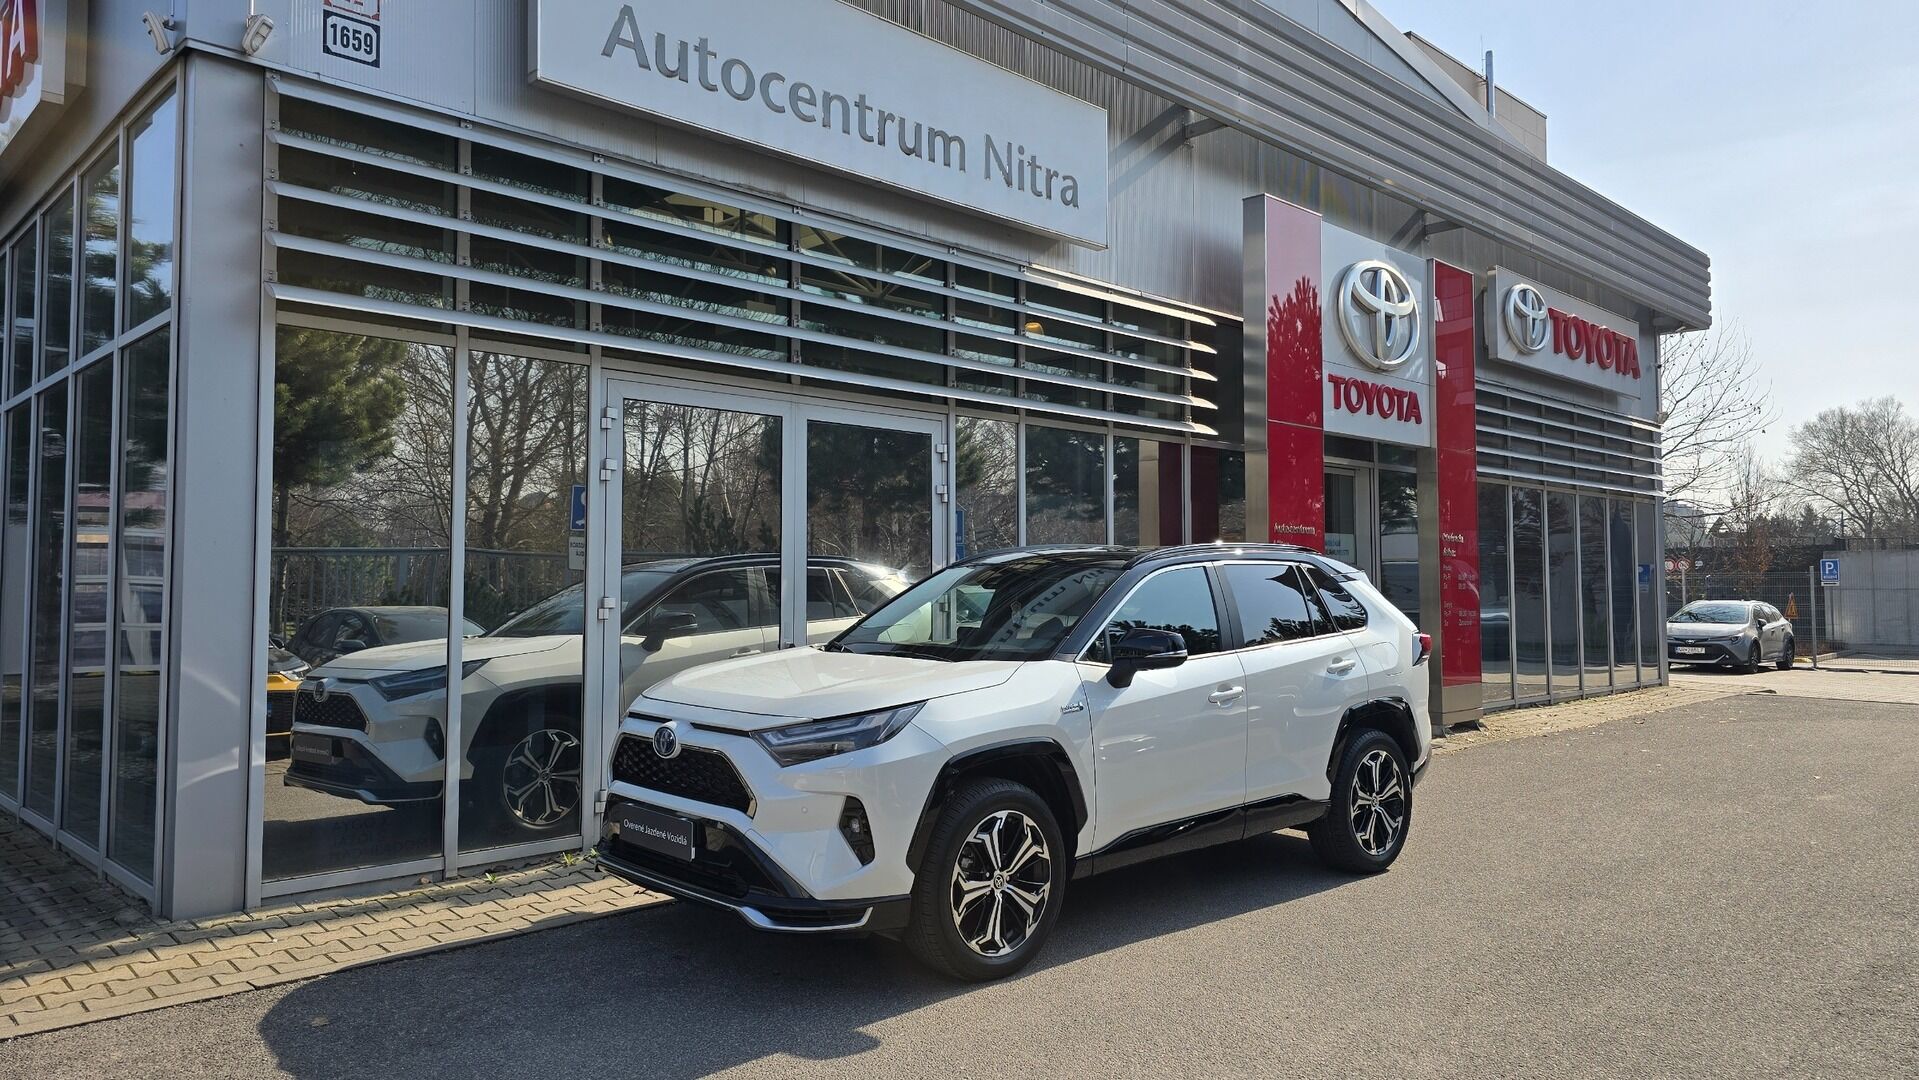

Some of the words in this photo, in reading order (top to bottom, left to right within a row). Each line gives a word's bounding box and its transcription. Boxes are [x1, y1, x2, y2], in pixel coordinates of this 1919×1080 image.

[330, 23, 373, 55] 1659
[601, 4, 967, 173] Autocentrum
[983, 133, 1080, 209] Nitra
[1547, 307, 1641, 380] TOYOTA
[1328, 373, 1423, 425] TOYOTA
[1825, 561, 1834, 574] P
[623, 818, 645, 833] Overené
[645, 825, 667, 840] Jazdené
[666, 831, 688, 846] Vozidlá
